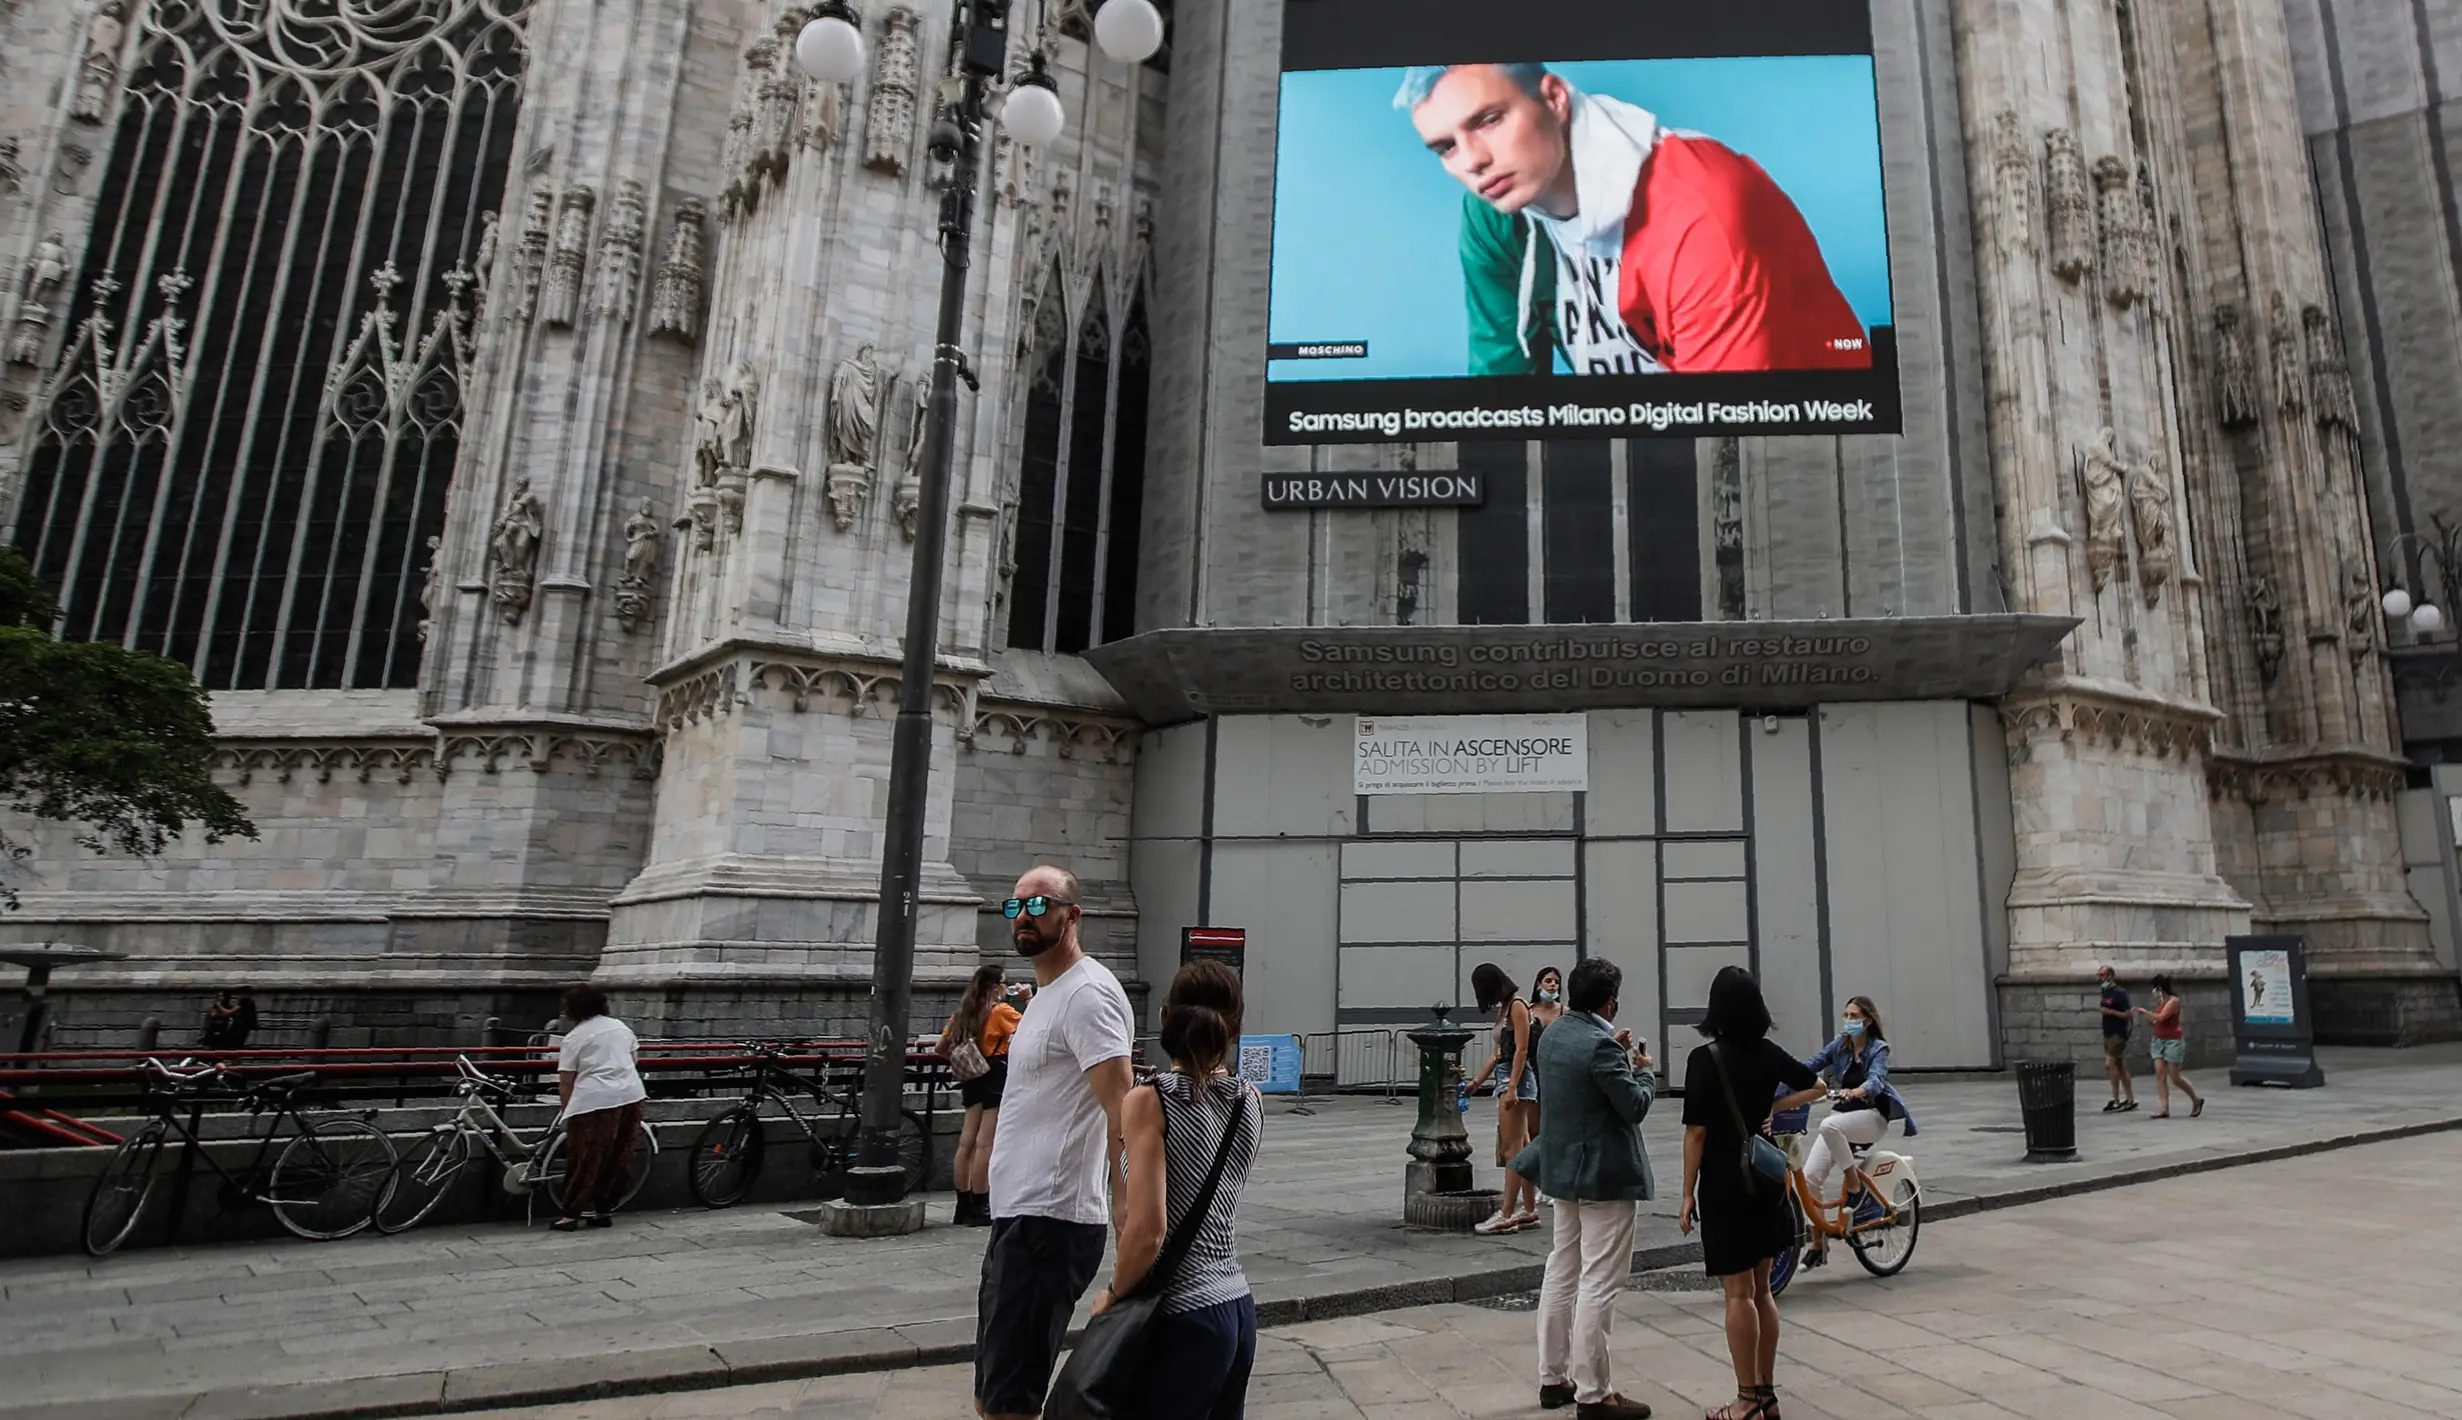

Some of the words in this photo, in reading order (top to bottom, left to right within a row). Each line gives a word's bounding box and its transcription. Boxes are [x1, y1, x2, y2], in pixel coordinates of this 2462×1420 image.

[1298, 345, 1364, 355] MOSCHINO
[1833, 338, 1863, 350] NOW
[1288, 409, 1401, 436] Samsung
[1404, 405, 1545, 430] broadcasts
[1548, 403, 1626, 427] Milano
[1629, 401, 1704, 431] Digital
[1707, 399, 1801, 424] Fashion
[1803, 399, 1874, 422] Week
[1268, 478, 1367, 501] URBAN
[1377, 476, 1477, 499] VISION
[1300, 639, 1460, 667] Samsung
[1469, 637, 1679, 663] contribuisce
[1690, 636, 1718, 657] al
[1729, 634, 1871, 657] restauro
[1292, 669, 1519, 691] architettonico
[1530, 667, 1579, 689] del
[1590, 666, 1711, 687] Duomo
[1720, 664, 1751, 685] di
[1761, 662, 1880, 684] Milano.
[1358, 740, 1423, 758] SALITA
[1428, 740, 1449, 757] IN
[1453, 738, 1572, 757] ASCENSORE
[1358, 758, 1469, 776] ADMISSION
[1476, 758, 1500, 774] BY
[1506, 756, 1544, 774] LIFT
